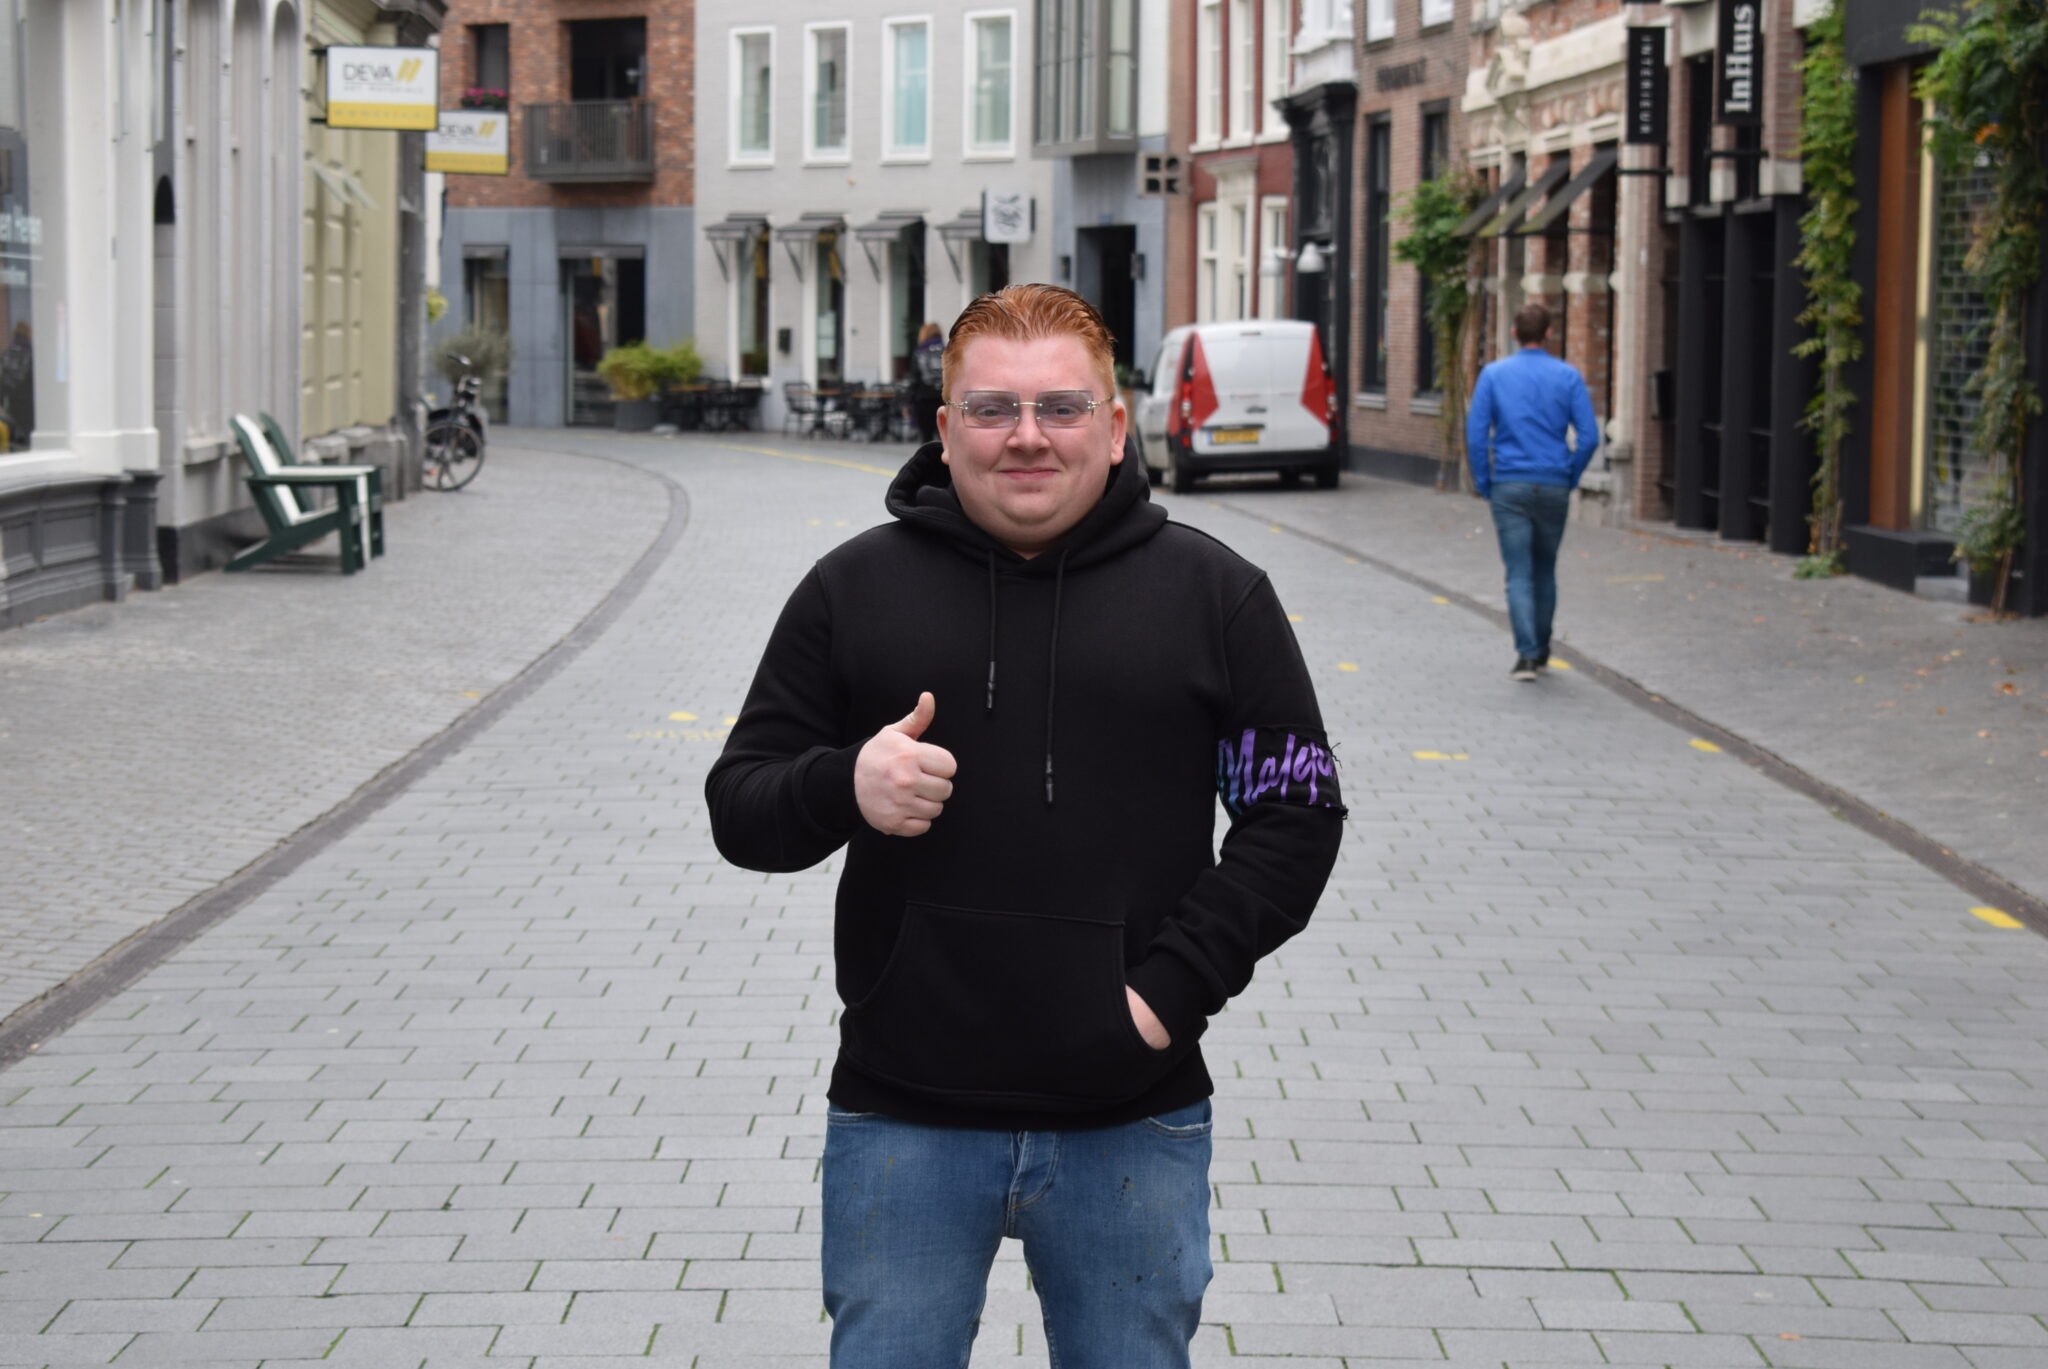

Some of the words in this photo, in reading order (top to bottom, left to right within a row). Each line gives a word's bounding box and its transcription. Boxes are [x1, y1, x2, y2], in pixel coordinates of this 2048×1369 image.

[1725, 4, 1754, 113] InHus
[343, 62, 393, 82] DEVA
[438, 123, 476, 137] DEVA
